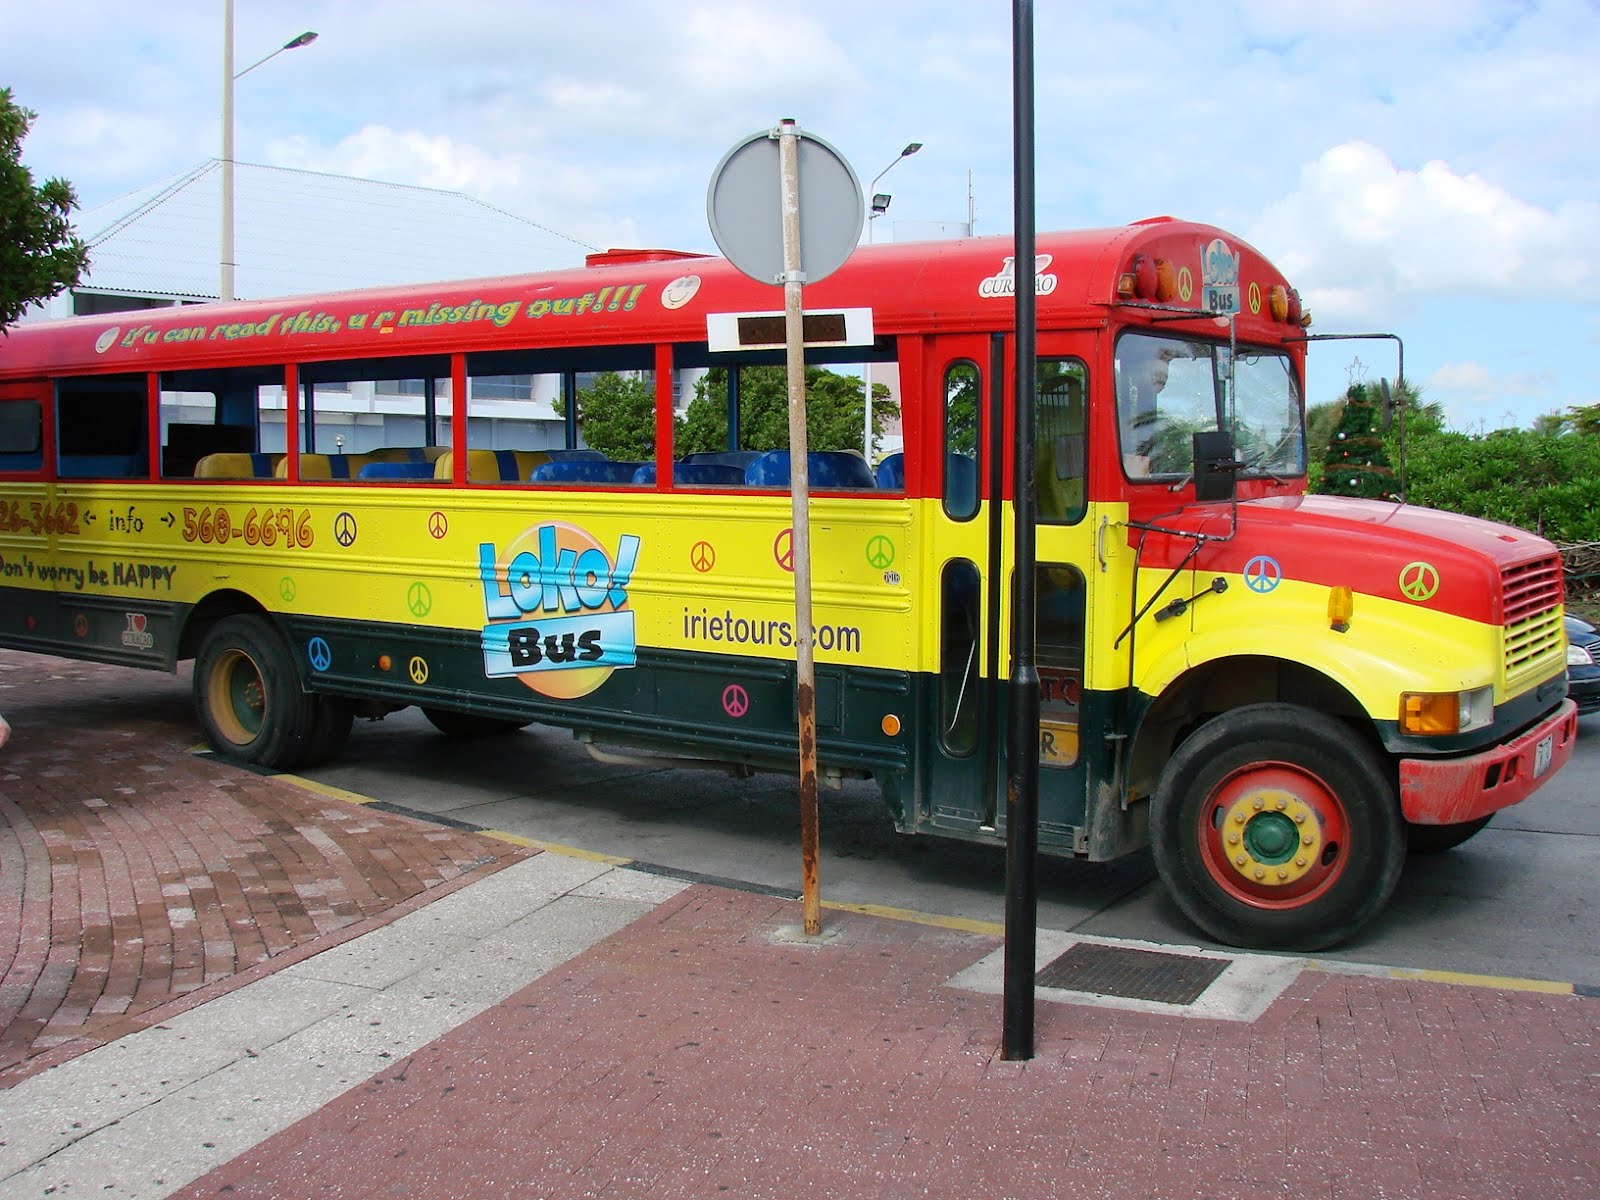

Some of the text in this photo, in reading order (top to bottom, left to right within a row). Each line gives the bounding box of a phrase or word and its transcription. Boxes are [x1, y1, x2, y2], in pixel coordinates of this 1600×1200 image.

[982, 276, 1054, 294] CURAO
[1208, 290, 1233, 311] Bus
[144, 330, 160, 344] u
[163, 326, 207, 342] can
[209, 313, 283, 340] read
[347, 312, 370, 329] u
[397, 299, 523, 327] missing
[109, 506, 144, 534] info
[182, 506, 315, 548] 560-6696
[37, 565, 85, 590] worry
[87, 560, 109, 587] be
[112, 562, 177, 591] HAPPY
[508, 628, 605, 668] Bus
[683, 606, 861, 653] irietours.om
